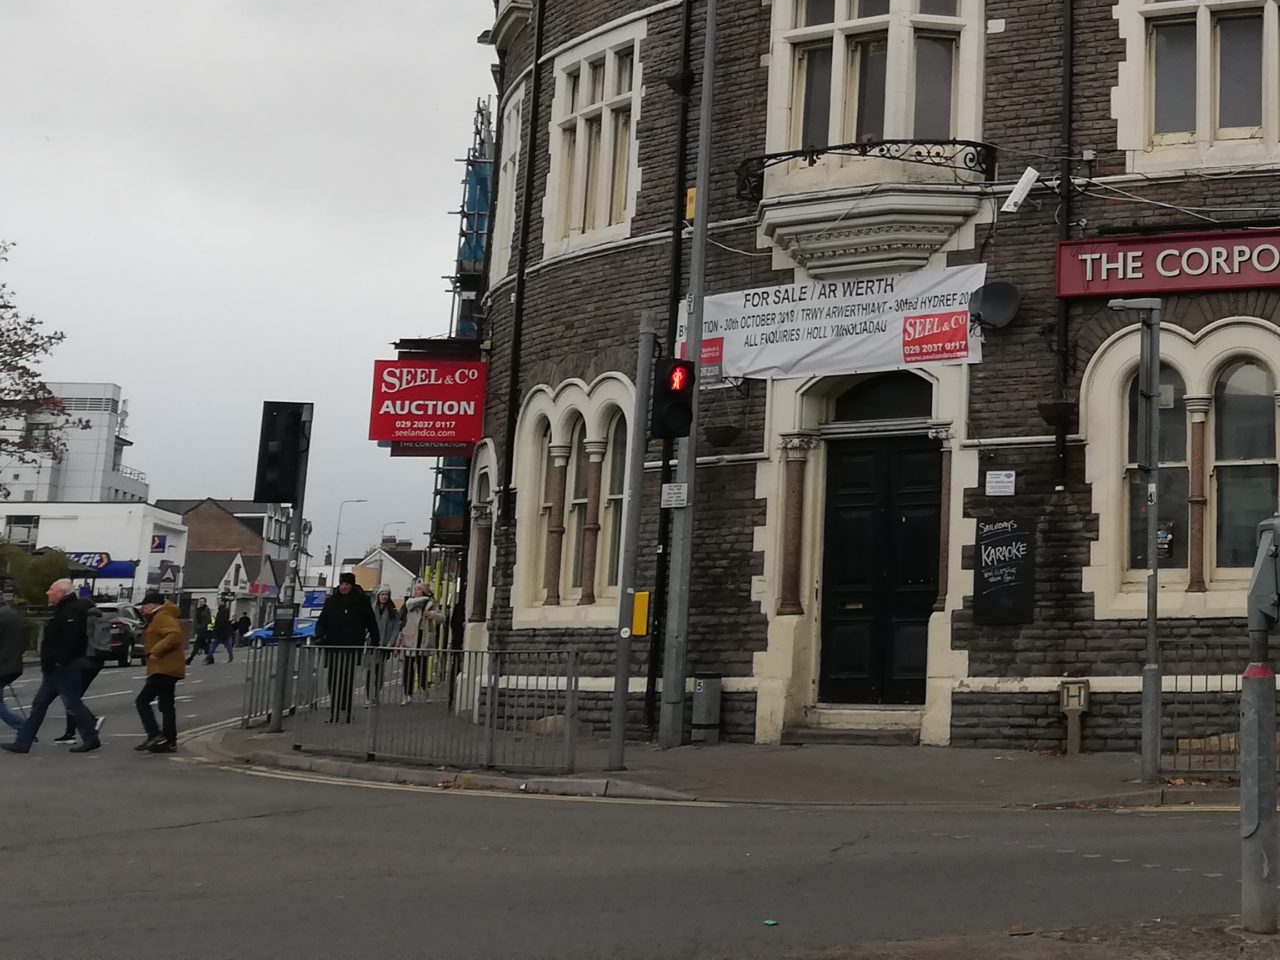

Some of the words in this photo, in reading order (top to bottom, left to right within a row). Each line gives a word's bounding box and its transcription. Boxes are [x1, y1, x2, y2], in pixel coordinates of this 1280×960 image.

[1078, 251, 1144, 282] THE
[744, 291, 769, 309] FOR
[773, 286, 808, 306] SALE
[810, 282, 816, 300] /
[817, 281, 838, 299] AR
[841, 277, 895, 297] WERTH
[724, 317, 739, 331] 30th
[740, 313, 777, 329] OCTOBER
[801, 307, 826, 322] TRWY
[826, 302, 887, 319] ARWERTHIANT
[920, 293, 957, 311] HYDREF
[744, 333, 758, 348] ALL
[760, 328, 801, 346] ENQUIRIES
[807, 325, 828, 340] HOLL
[905, 318, 941, 341] SEEL
[942, 321, 951, 332] &
[904, 345, 920, 354] 029
[922, 343, 943, 353] 2037
[944, 341, 966, 351] 0117
[382, 367, 442, 393] SEEL
[444, 375, 454, 385] &
[379, 400, 475, 415] AUCTION
[394, 428, 456, 437] seelandco.com
[981, 541, 1028, 567] KARAOKE
